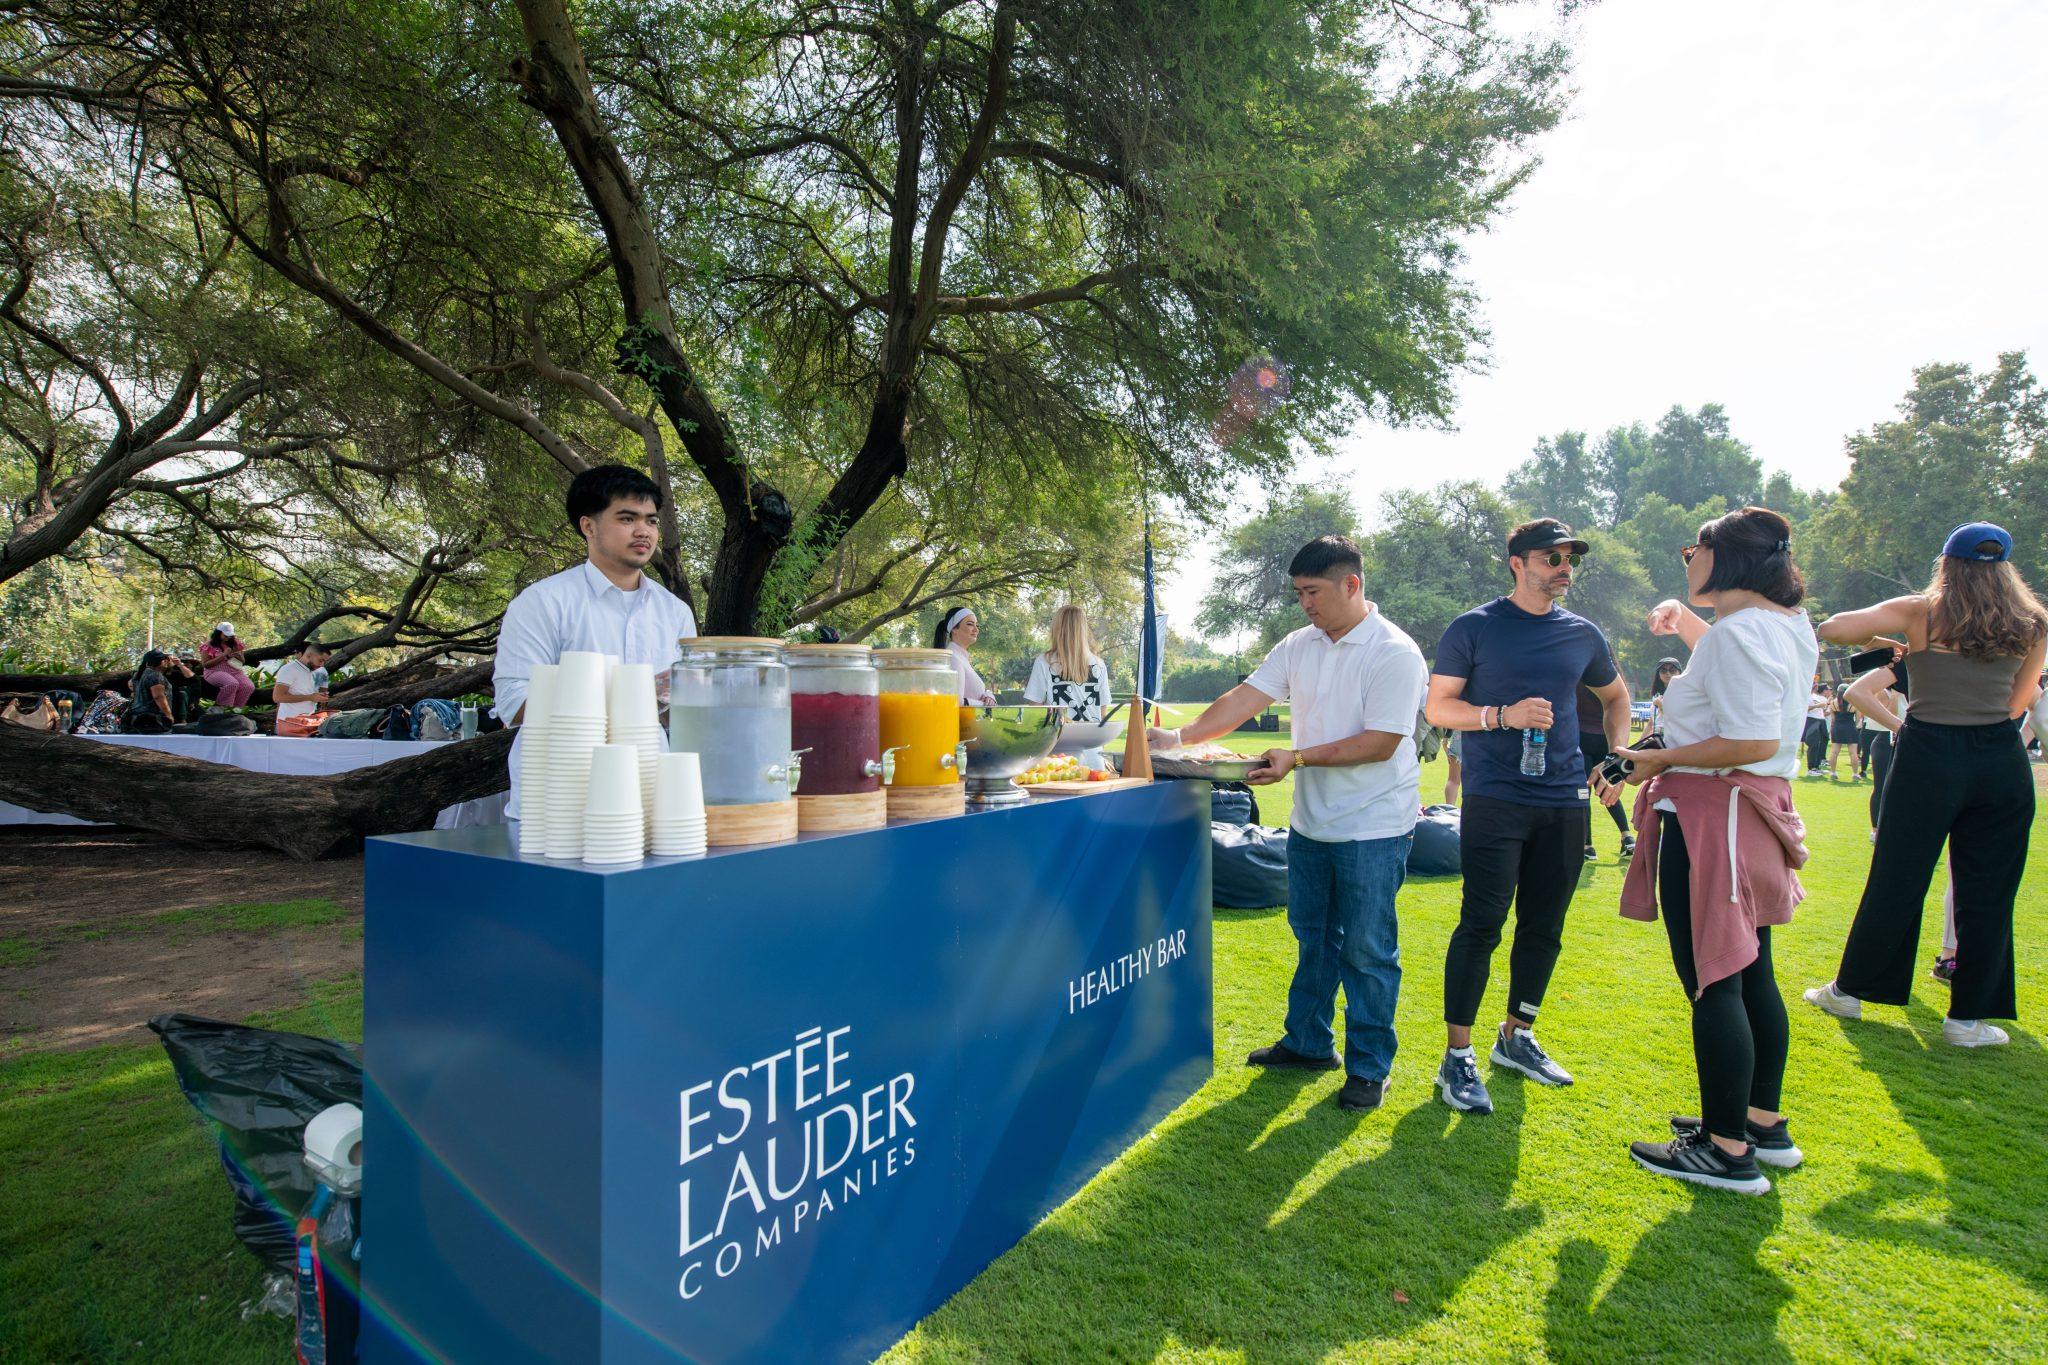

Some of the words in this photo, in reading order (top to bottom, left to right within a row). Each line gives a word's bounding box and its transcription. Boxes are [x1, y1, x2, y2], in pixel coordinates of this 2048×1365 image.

[1069, 943, 1153, 1014] HEALTHY
[1158, 929, 1187, 968] BAR
[678, 1137, 916, 1300] COMPANIES
[679, 1072, 917, 1258] LAUDER
